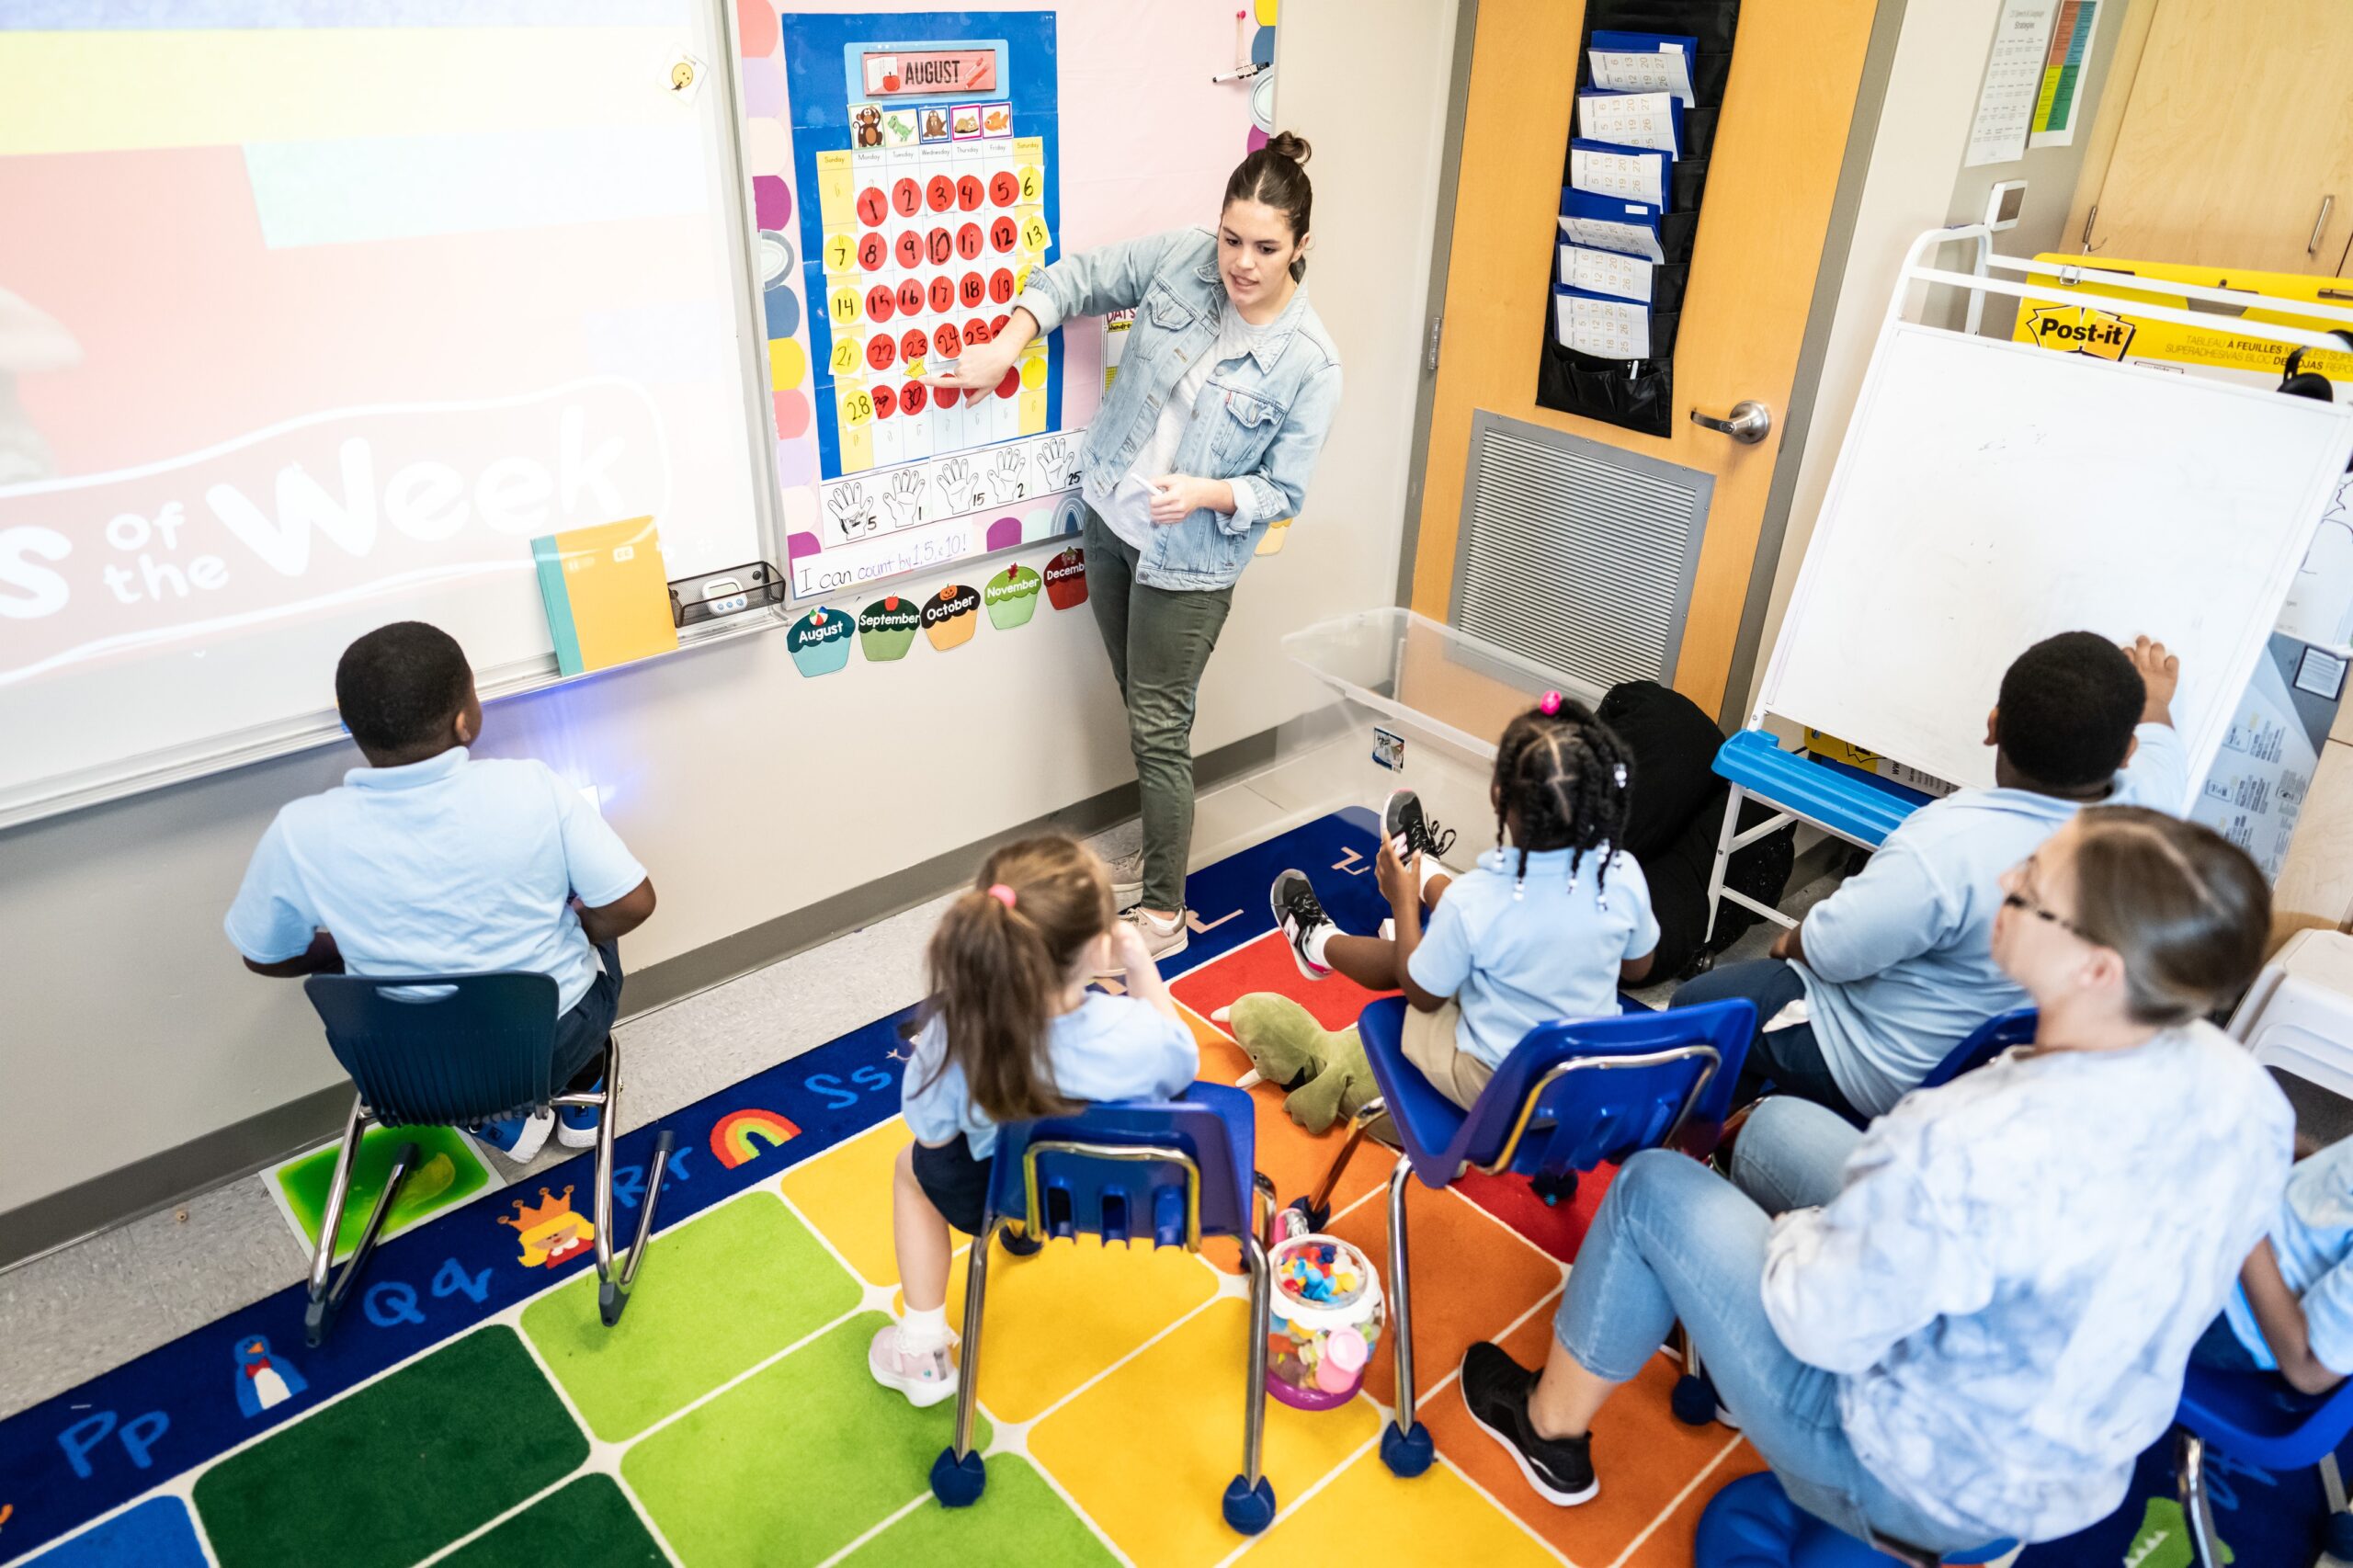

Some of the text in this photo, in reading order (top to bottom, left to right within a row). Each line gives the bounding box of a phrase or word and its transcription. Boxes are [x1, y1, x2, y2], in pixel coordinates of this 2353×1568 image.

[904, 60, 961, 85] AUGUST
[1625, 57, 1637, 85] 12 13
[1640, 57, 1652, 85] 19 20
[1655, 57, 1668, 86] 26 27
[1612, 99, 1623, 131] 12 13
[1626, 98, 1635, 111] 20
[1641, 98, 1650, 110] 27
[1628, 119, 1637, 131] 19
[1643, 119, 1652, 131] 26
[824, 142, 1040, 165] Sunday Monday Tuesday Wednesday Thursday Friday Saturday
[1605, 157, 1613, 187] 12 13
[1618, 158, 1627, 189] 19 20
[1632, 160, 1641, 192] 26 27
[868, 176, 1034, 221] 1 2 3 4 5 6
[834, 225, 1043, 266] 7 8 9 10 11 12 13
[1594, 255, 1604, 283] 12 13
[1608, 257, 1618, 287] 19 20
[1621, 260, 1632, 290] 26 27
[837, 297, 854, 317] 14
[871, 290, 891, 314] 15
[901, 290, 919, 306] 16
[932, 285, 948, 304] 17
[965, 281, 980, 299] 18
[997, 278, 1010, 301] 19
[1108, 323, 1132, 332] Hundre
[1591, 302, 1600, 347] 11 12 13
[1604, 304, 1615, 349] 18 19 20
[1619, 305, 1629, 353] 25 26 27
[2040, 317, 2123, 346] Post-it
[835, 346, 852, 367] 21
[872, 344, 893, 362] 22
[906, 339, 927, 358] 23
[938, 325, 959, 354] 24
[965, 331, 989, 346] 25
[2165, 344, 2244, 362] SUPERADHESIVAS
[2245, 354, 2273, 365] BLOC
[2297, 359, 2324, 370] OJAS
[2186, 335, 2226, 348] TABLEAU
[2227, 337, 2234, 349] À
[2236, 341, 2283, 354] FEUILLES
[847, 395, 871, 421] 28
[904, 386, 922, 411] 30
[205, 404, 628, 577] Week
[1068, 471, 1083, 486] 25
[972, 492, 986, 507] 15
[106, 501, 188, 551] of
[801, 566, 813, 594] I
[819, 571, 852, 591] can
[857, 559, 895, 581] count
[898, 552, 912, 571] by
[945, 533, 967, 559] 10!
[1046, 560, 1085, 580] Decemb
[103, 553, 231, 605] the
[986, 577, 1040, 598] November
[858, 612, 920, 629] September
[926, 594, 975, 621] October
[798, 619, 844, 643] August
[803, 1064, 893, 1110] Ss
[612, 1143, 694, 1209] Rr
[361, 1256, 494, 1331] Qq
[56, 1409, 171, 1480] Pp
